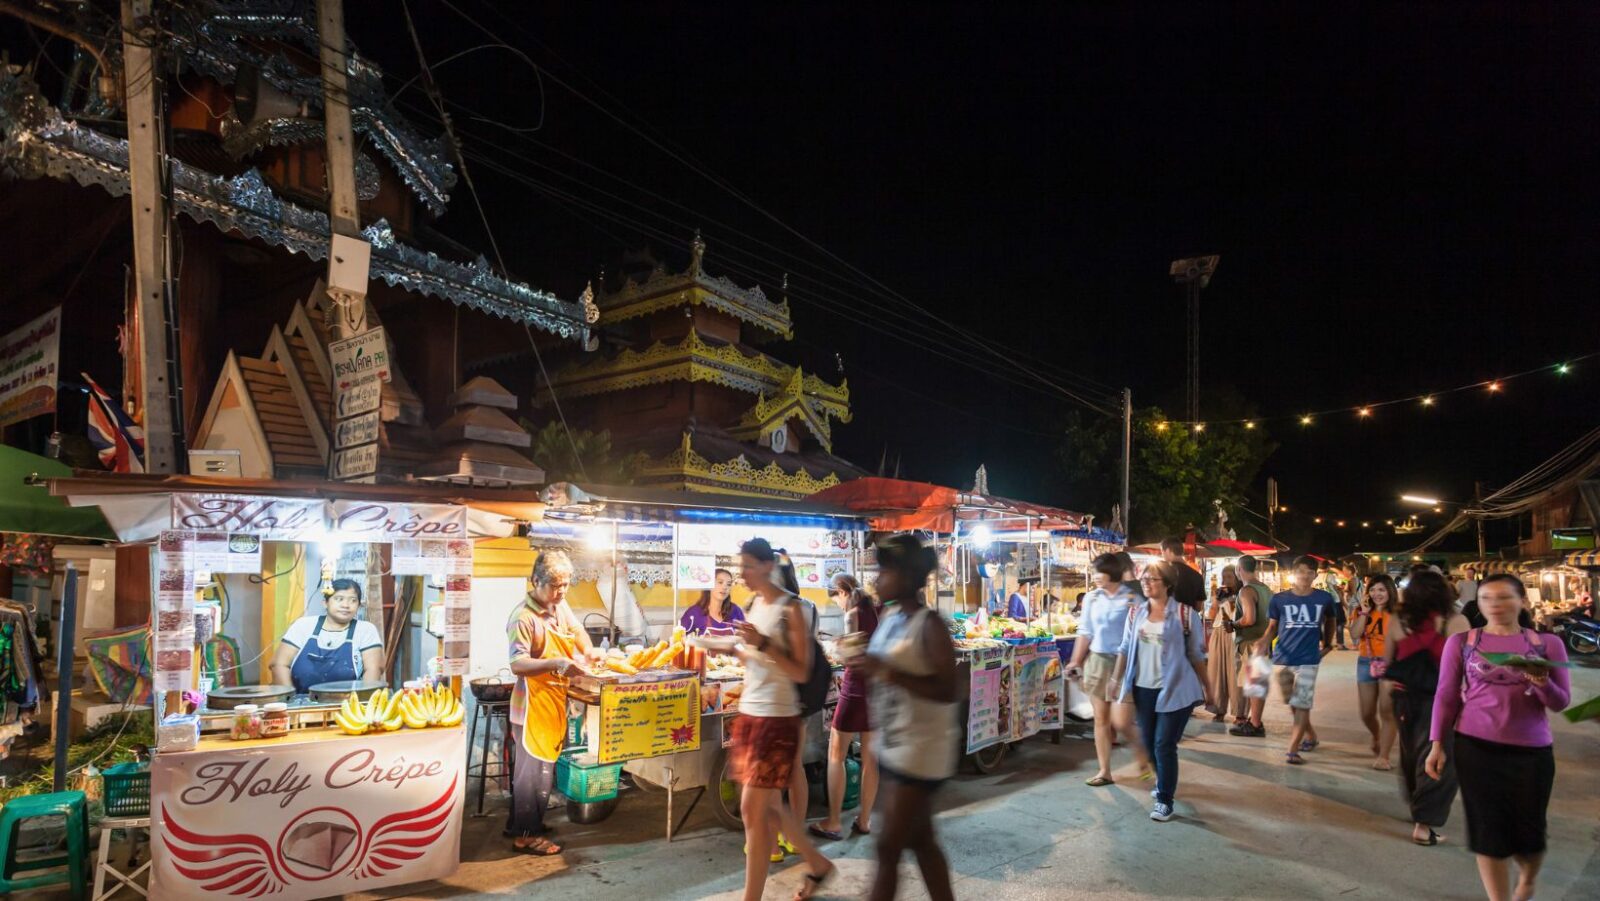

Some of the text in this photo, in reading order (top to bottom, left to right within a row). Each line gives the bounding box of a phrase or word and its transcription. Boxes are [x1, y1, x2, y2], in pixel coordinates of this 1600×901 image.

[338, 504, 461, 538] Crêpe
[614, 684, 659, 693] POTATO
[181, 749, 444, 808] Holy Crêpe
